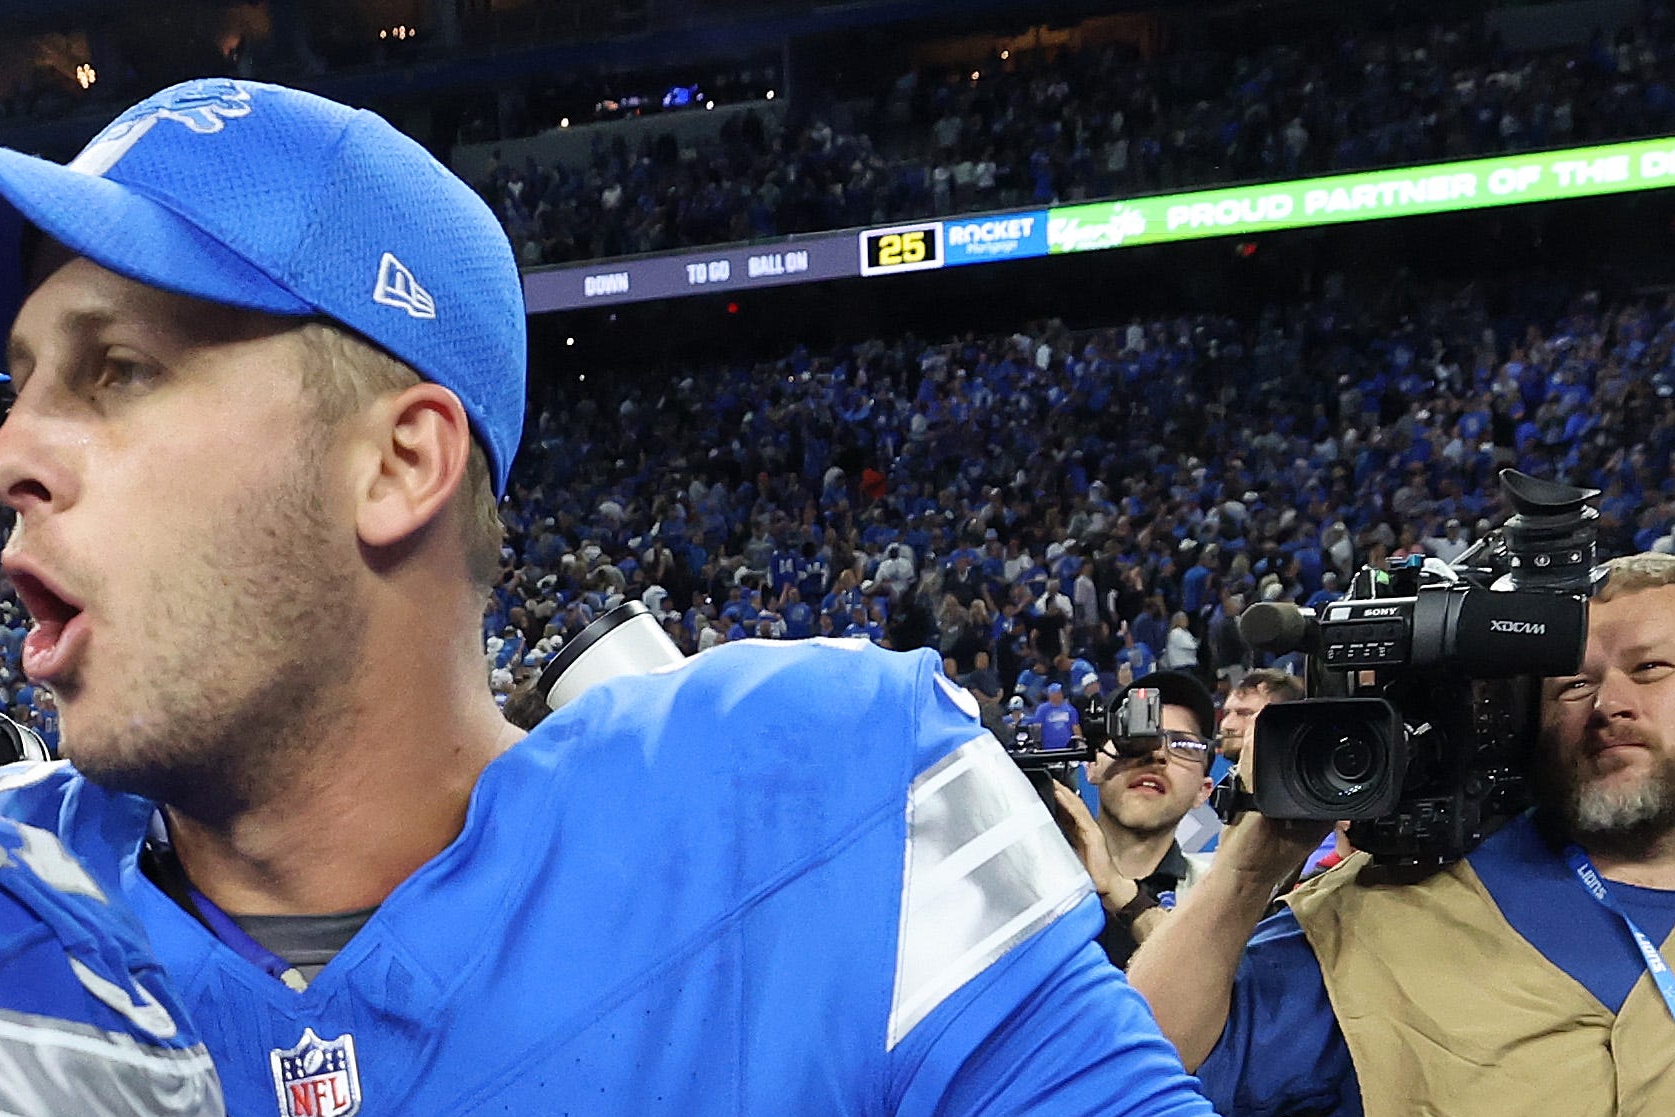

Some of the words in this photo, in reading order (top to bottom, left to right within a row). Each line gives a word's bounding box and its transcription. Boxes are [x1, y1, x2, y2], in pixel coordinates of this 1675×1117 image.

[1166, 194, 1294, 230] PROUD
[1304, 173, 1477, 215] PARTNER
[1488, 165, 1542, 195] OF
[1552, 155, 1629, 187] THE
[948, 218, 1035, 245] ROCKET
[878, 231, 926, 266] 25
[686, 263, 707, 285] TO
[708, 260, 730, 282] GO
[748, 254, 784, 277] BALL
[785, 250, 808, 273] ON
[584, 272, 629, 296] DOWN
[1363, 607, 1399, 617] SONY
[1490, 619, 1546, 635] XDCAM
[1577, 863, 1607, 900] LIONS
[290, 1076, 347, 1117] NFL
